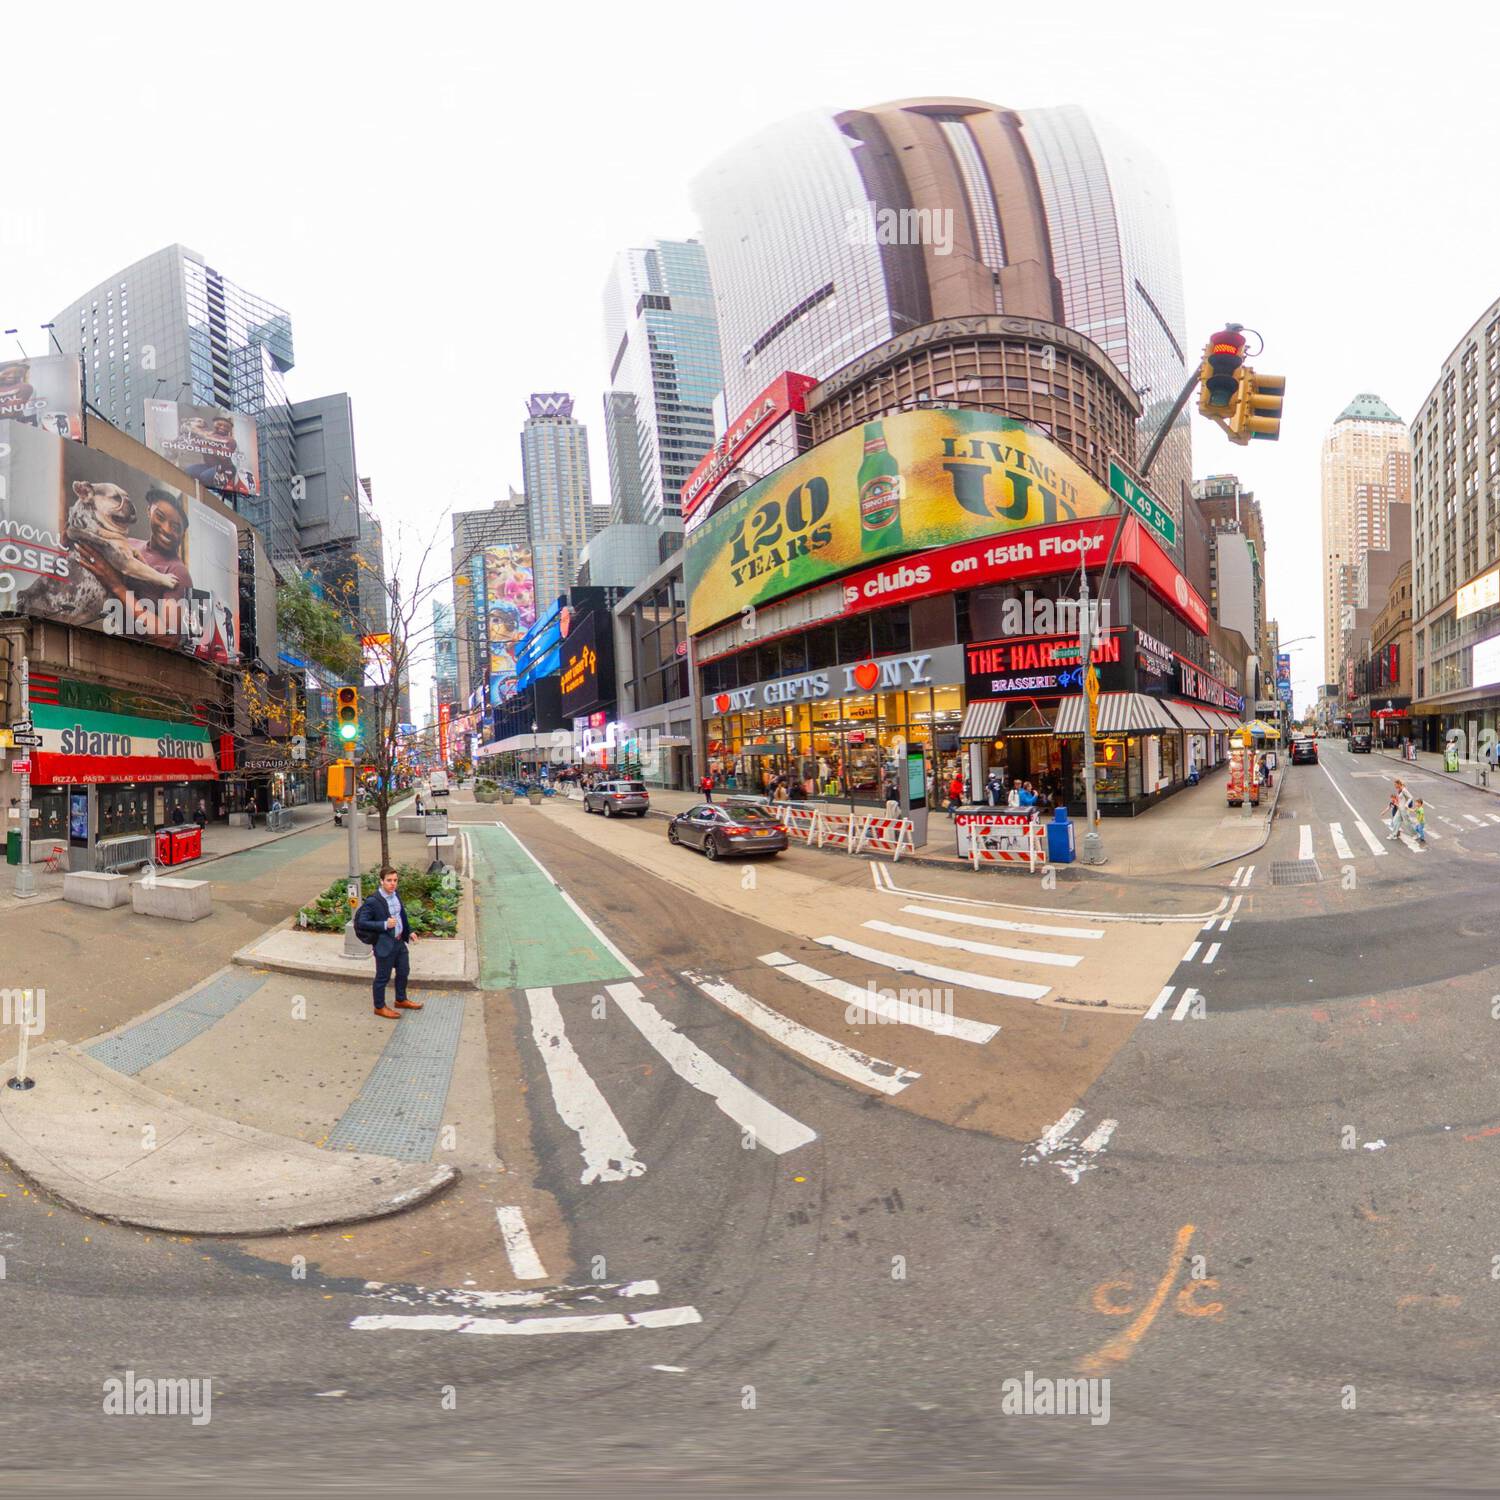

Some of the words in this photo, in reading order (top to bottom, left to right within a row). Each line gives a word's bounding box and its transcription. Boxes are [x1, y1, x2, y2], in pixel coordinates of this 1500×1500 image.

[825, 318, 988, 396] BROADWAY
[2, 400, 48, 414] NULO
[534, 396, 566, 411] W
[161, 441, 214, 455] CHOOSES
[217, 449, 245, 461] NULO
[941, 438, 1056, 489] LIVING
[1060, 477, 1078, 505] IT
[1123, 478, 1134, 501] W
[1137, 495, 1152, 517] 49
[1155, 511, 1166, 532] St
[729, 476, 830, 566] 120
[730, 522, 832, 588] YEARS
[863, 565, 931, 597] clubs
[950, 555, 977, 574] on
[984, 545, 1032, 567] 15th
[1039, 534, 1104, 557] Floor
[1139, 630, 1169, 660] PARKING
[968, 646, 1005, 675] THE
[763, 673, 829, 705] GIFTS
[991, 675, 1057, 692] BRASSERIE
[751, 717, 782, 729] LUGAGE
[60, 723, 132, 758] sbarro
[157, 733, 204, 760] sbarro
[244, 760, 298, 769] RESTAURANT
[52, 776, 78, 784] PIZZA
[82, 775, 105, 783] PASTA
[957, 815, 1029, 826] CHICAGO
